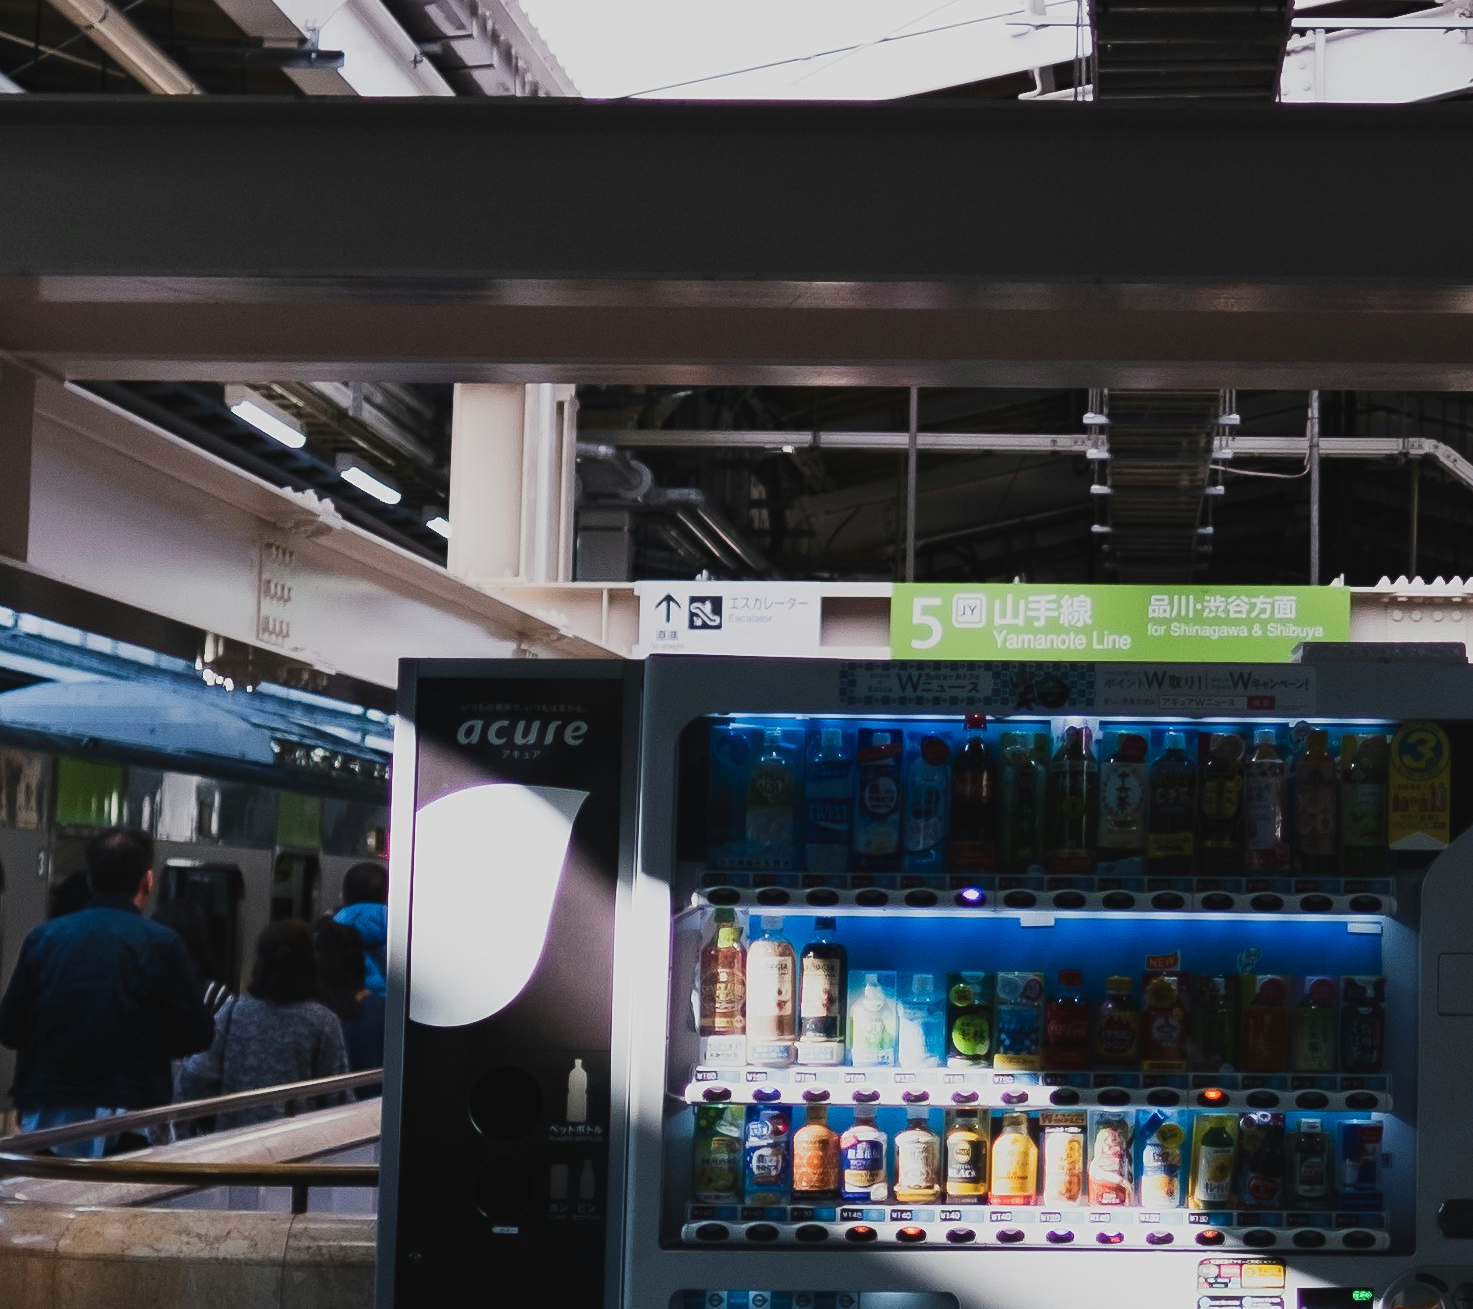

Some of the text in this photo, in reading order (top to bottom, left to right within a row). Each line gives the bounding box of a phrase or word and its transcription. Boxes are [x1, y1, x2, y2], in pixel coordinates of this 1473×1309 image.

[729, 596, 808, 611] エスカレーター
[960, 604, 977, 618] JY
[993, 593, 1093, 628] 山手線
[1148, 594, 1297, 619] 品川・渋谷方面
[910, 596, 943, 651] 5
[1147, 622, 1324, 639] for Shinagawa & Shibuya
[993, 630, 1132, 650] Yamanote Line
[919, 681, 980, 694] ニュース
[456, 719, 589, 746] acure
[501, 750, 542, 760] アキュア
[1400, 732, 1437, 771] 3
[1148, 955, 1179, 969] NEW
[550, 1202, 569, 1213] カン
